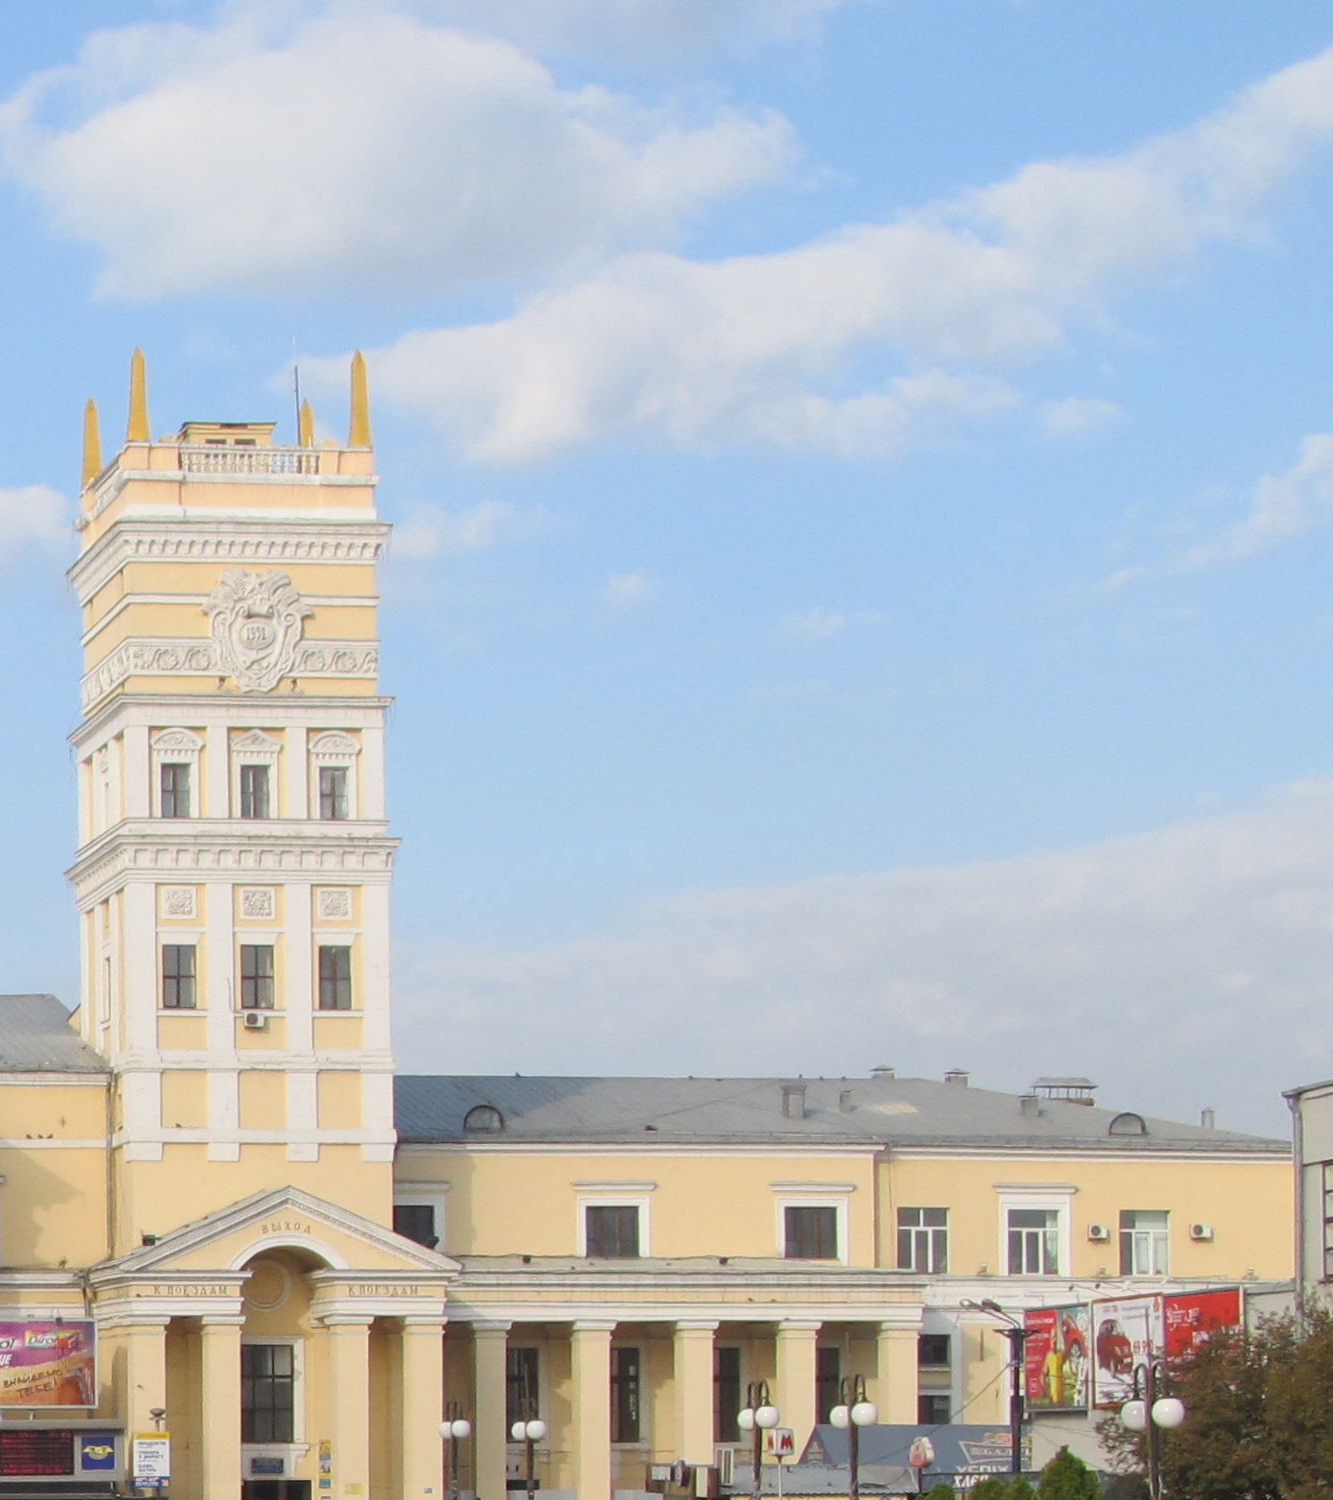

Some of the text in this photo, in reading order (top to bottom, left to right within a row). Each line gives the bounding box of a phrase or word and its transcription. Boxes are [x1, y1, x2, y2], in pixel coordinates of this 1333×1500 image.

[261, 1223, 312, 1234] ВЫХОД
[154, 1285, 228, 1297] К ПОЕЗДАМ
[348, 1285, 419, 1297] К ПОЕЗДАМ
[780, 1433, 793, 1450] М
